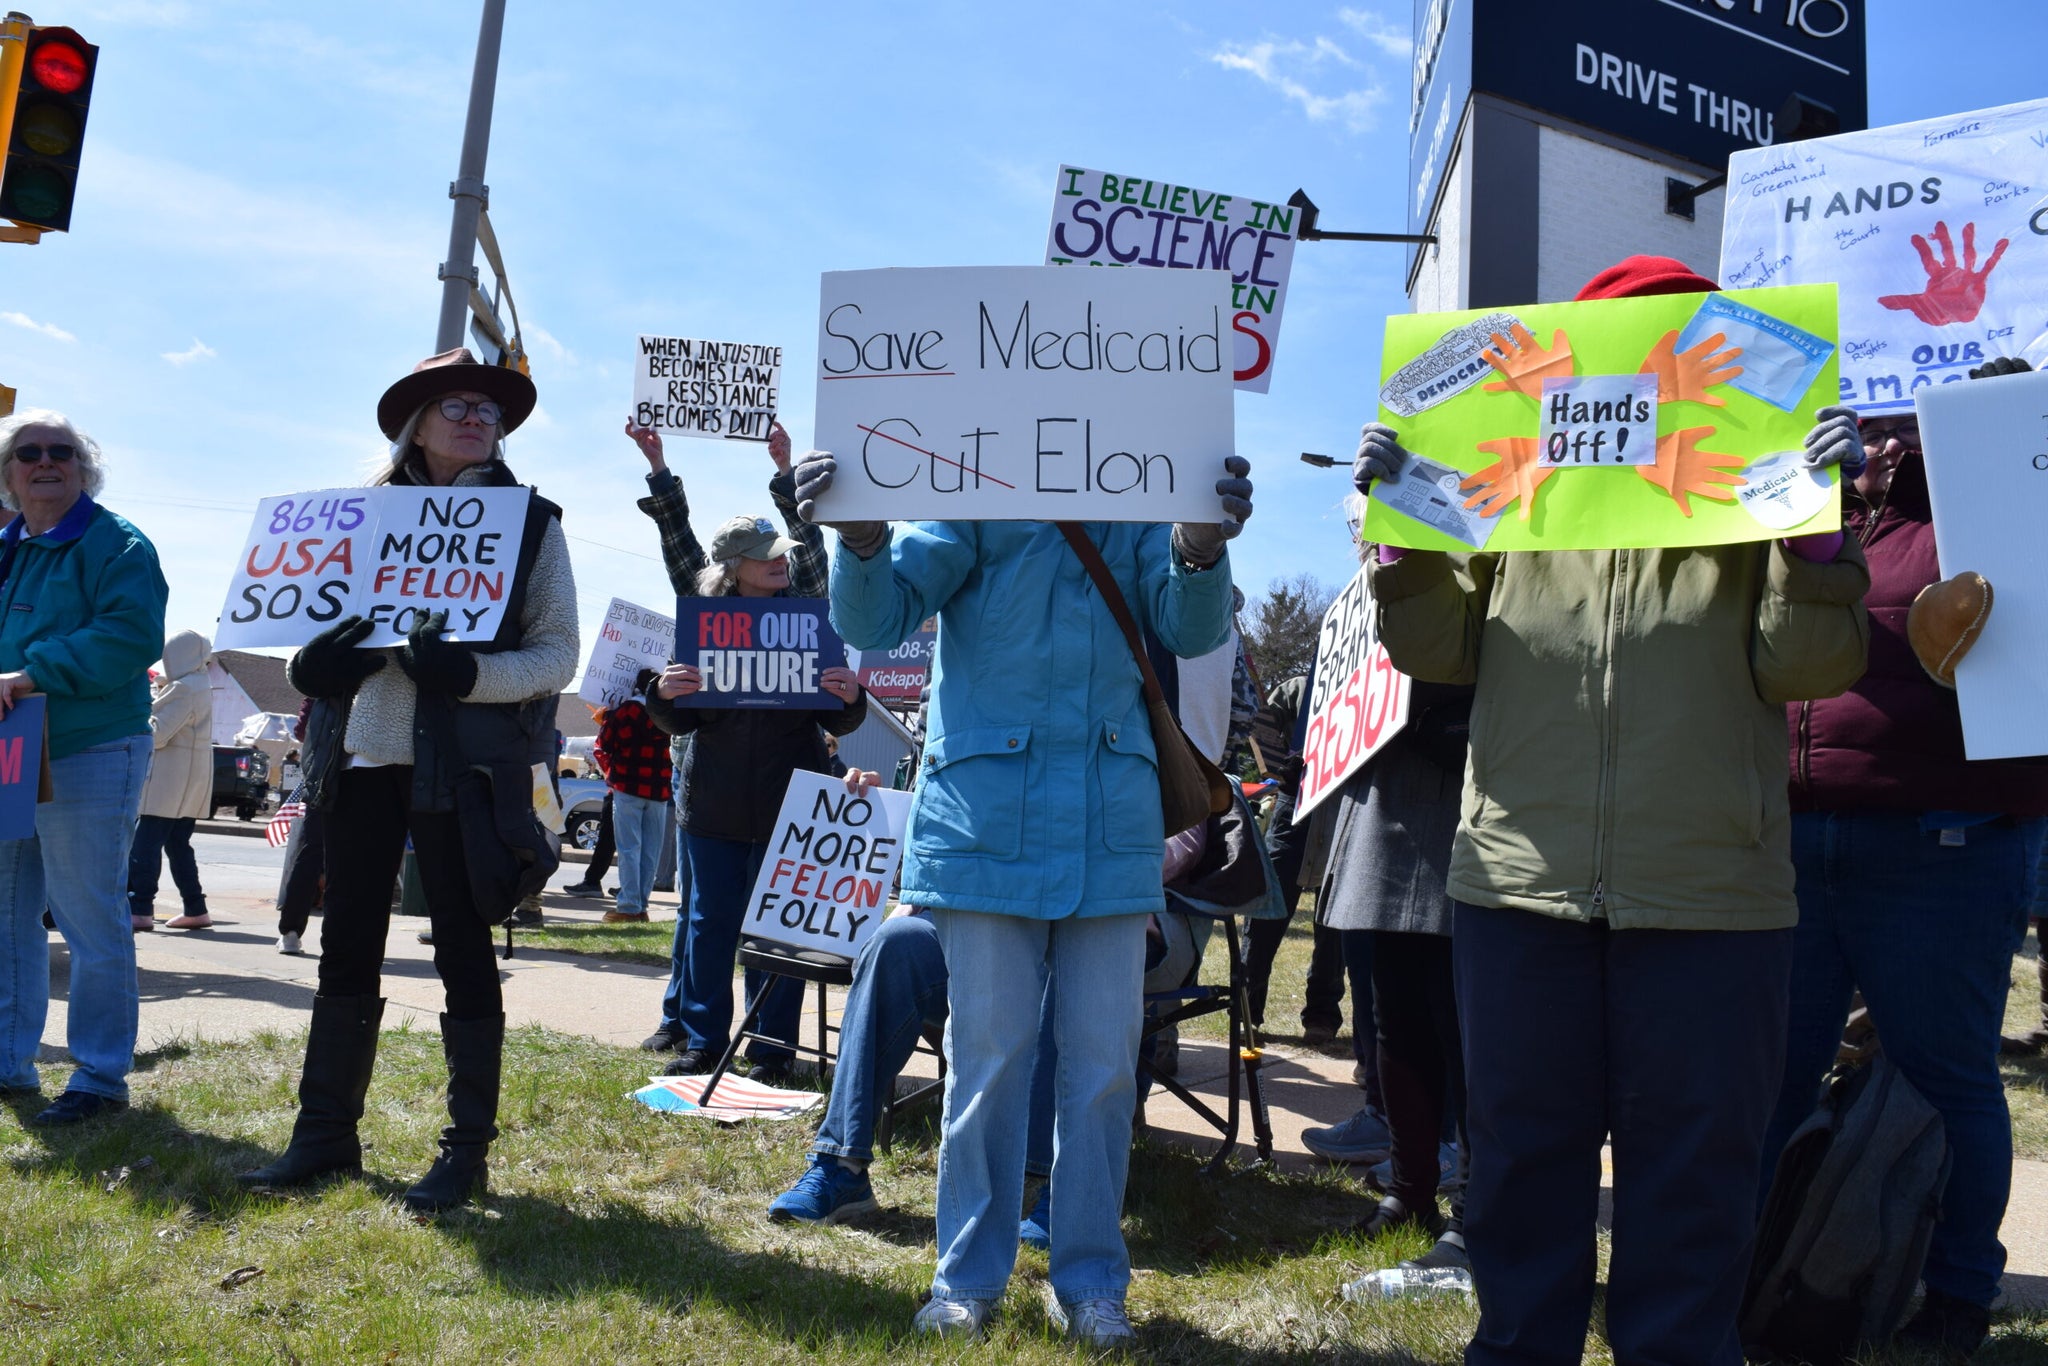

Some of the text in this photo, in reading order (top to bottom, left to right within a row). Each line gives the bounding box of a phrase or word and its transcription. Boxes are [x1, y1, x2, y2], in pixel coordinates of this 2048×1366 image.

[1576, 43, 1773, 146] DRIVE THRU
[1924, 122, 1980, 147] Farmers
[1752, 164, 1826, 197] Greenland
[1983, 181, 2010, 194] Our
[1061, 168, 1293, 233] I BELIEVE IN
[1785, 177, 1942, 223] HANDS
[1054, 199, 1292, 287] SCIENCE
[1834, 226, 1854, 240] the
[1839, 223, 1881, 250] Courts
[1754, 247, 1766, 262] of
[1232, 284, 1277, 314] IN
[822, 300, 1222, 374] Save Medicaid
[1711, 305, 1822, 356] SOCIAL SECURITY
[1845, 339, 1870, 354] Our
[1987, 326, 2015, 341] DEI
[641, 337, 782, 367] WHEN INJUSTICE
[1851, 340, 1887, 362] Rights
[1911, 341, 1985, 365] OUR
[649, 356, 773, 386] BECOMES LAW
[667, 380, 777, 409] RESISTANCE
[1551, 393, 1649, 424] Hands
[637, 401, 777, 440] BECOMES DUTY
[862, 417, 1174, 494] Cut Elon
[1742, 468, 1798, 500] Medicaid
[268, 496, 366, 535] 8645
[418, 496, 485, 529] NO
[246, 537, 354, 579] USA
[379, 532, 503, 565] MORE
[373, 565, 504, 603] FELON
[230, 580, 350, 624] SOS
[368, 604, 490, 636] FOLY
[641, 614, 676, 637] NOT
[698, 612, 819, 649] FOR OUR
[602, 623, 622, 642] RED
[641, 637, 666, 657] BLUE
[699, 650, 819, 693] FUTURE
[1313, 609, 1371, 716] SPEAK
[868, 670, 925, 689] Kickapo
[811, 788, 872, 827] NO
[779, 822, 897, 875] MORE
[769, 858, 883, 908] FELON
[755, 893, 870, 943] FOLLY
